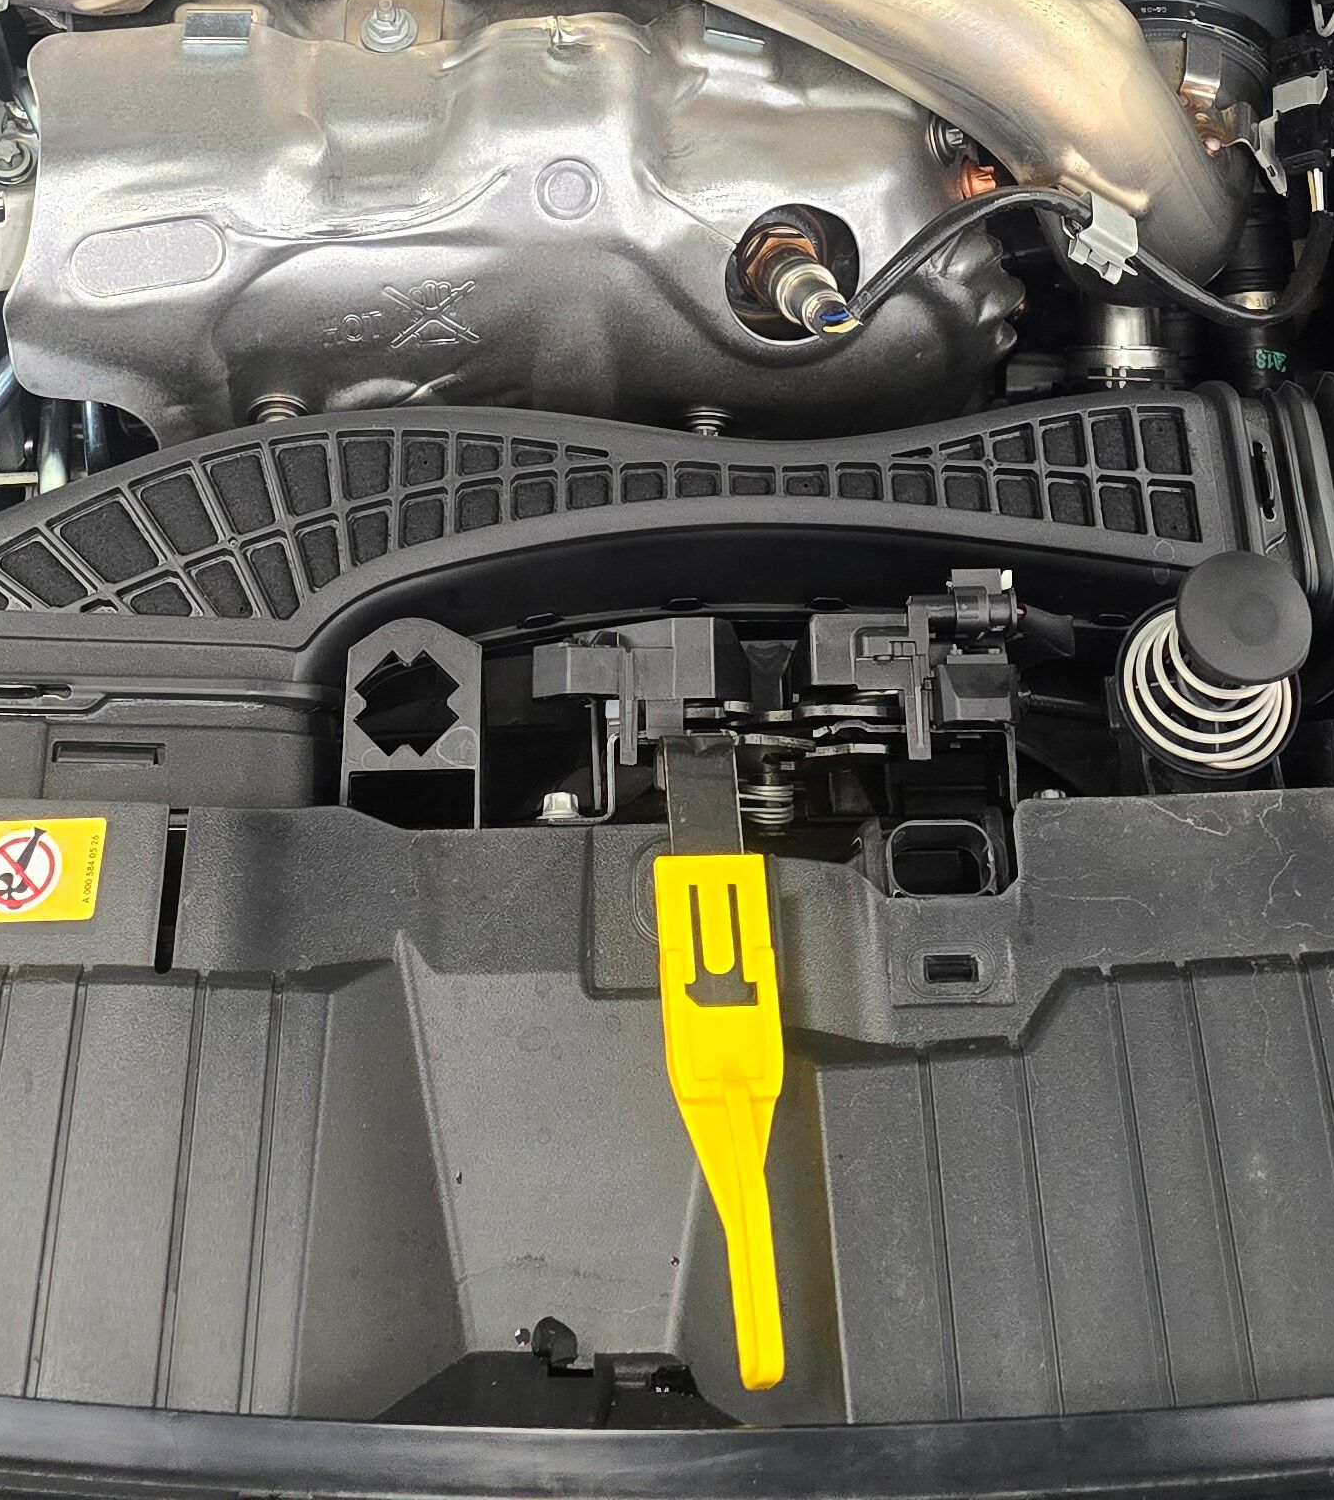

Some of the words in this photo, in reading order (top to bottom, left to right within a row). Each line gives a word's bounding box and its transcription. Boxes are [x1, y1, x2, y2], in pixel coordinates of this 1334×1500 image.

[90, 834, 100, 846] 26
[88, 847, 98, 859] 05
[85, 860, 95, 877] 584
[83, 879, 93, 895] 000
